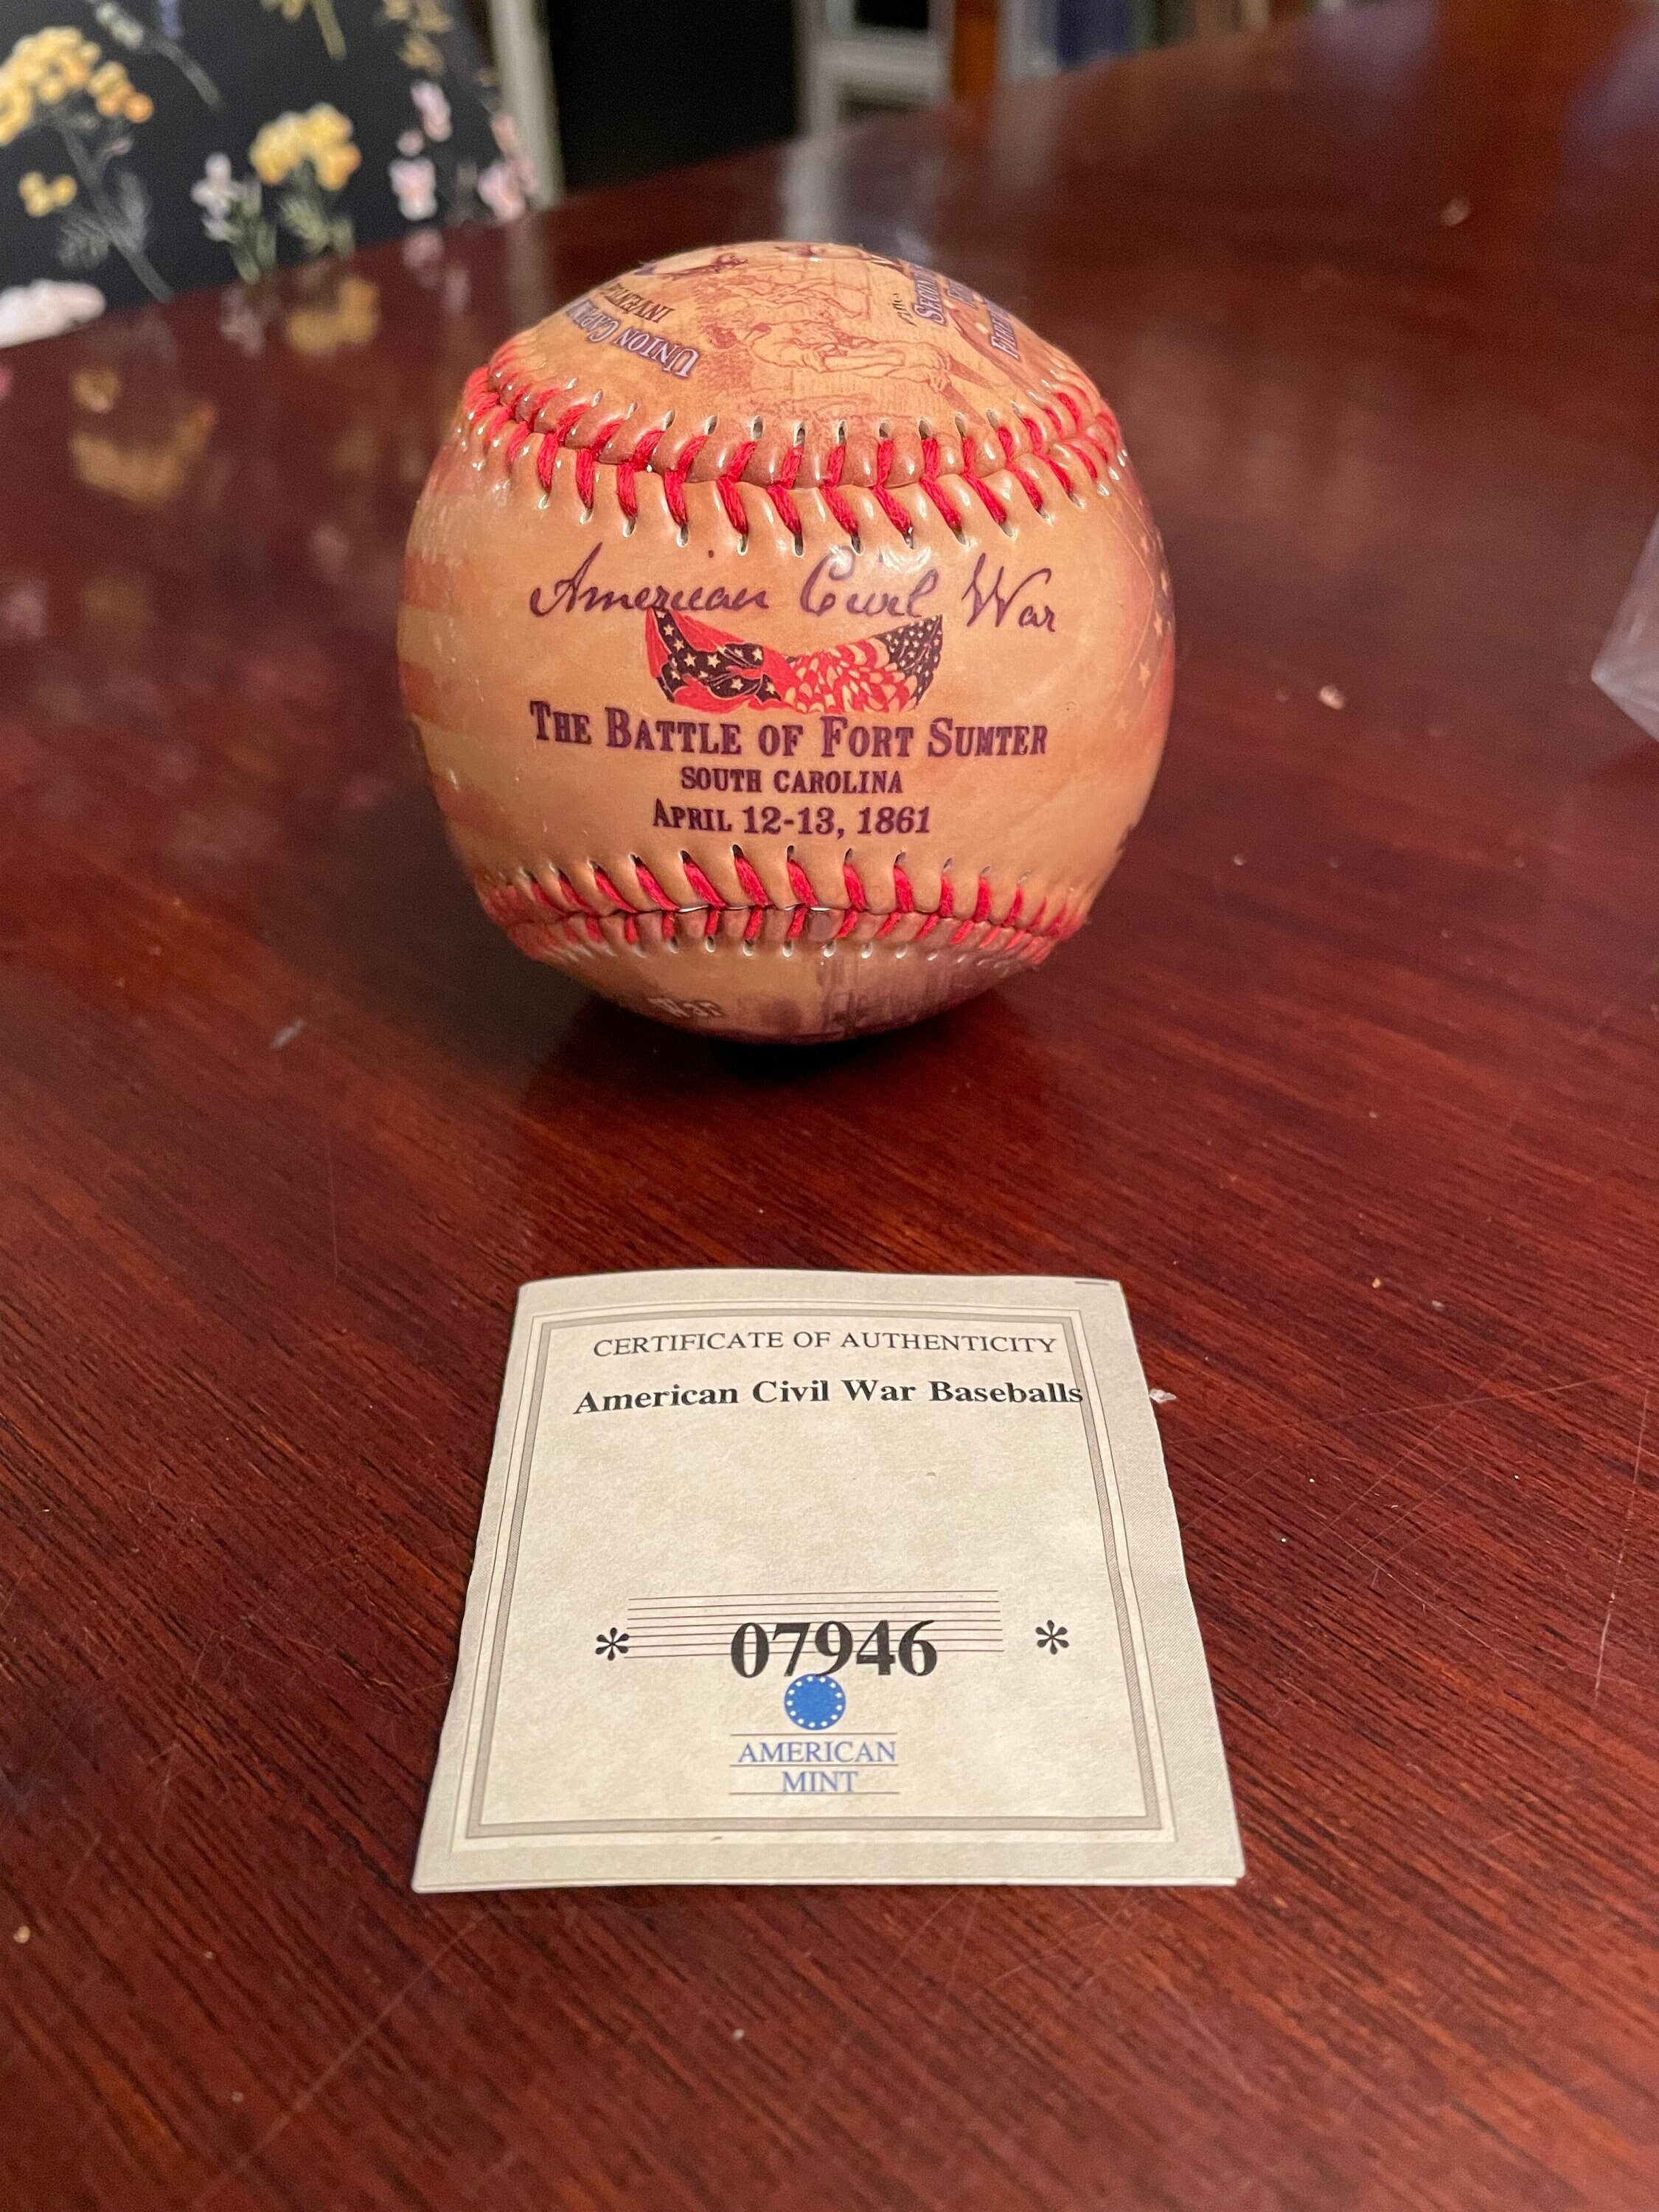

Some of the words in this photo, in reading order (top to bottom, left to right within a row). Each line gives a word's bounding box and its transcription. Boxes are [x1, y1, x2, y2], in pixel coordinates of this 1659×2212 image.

[613, 326, 700, 378] UNION
[529, 542, 769, 616] American
[800, 545, 938, 616] Civil
[961, 553, 1054, 632] War
[758, 725, 804, 757] OF
[681, 765, 762, 793] SOUTH
[773, 770, 903, 794] CAROLINA
[653, 797, 732, 832] APRIL
[743, 805, 845, 840] 12-13,
[857, 806, 931, 835] 1861
[594, 1331, 784, 1358] CERTIFICATE
[793, 1331, 831, 1349] OF
[841, 1332, 1057, 1354] AUTHENTICITY
[573, 1383, 739, 1415] American
[752, 1380, 830, 1403] Civil
[843, 1380, 917, 1402] War
[928, 1380, 1083, 1404] Baseballs
[731, 1620, 939, 1678] 07946
[738, 1741, 896, 1763] AMERICAN
[782, 1771, 859, 1792] MINT
